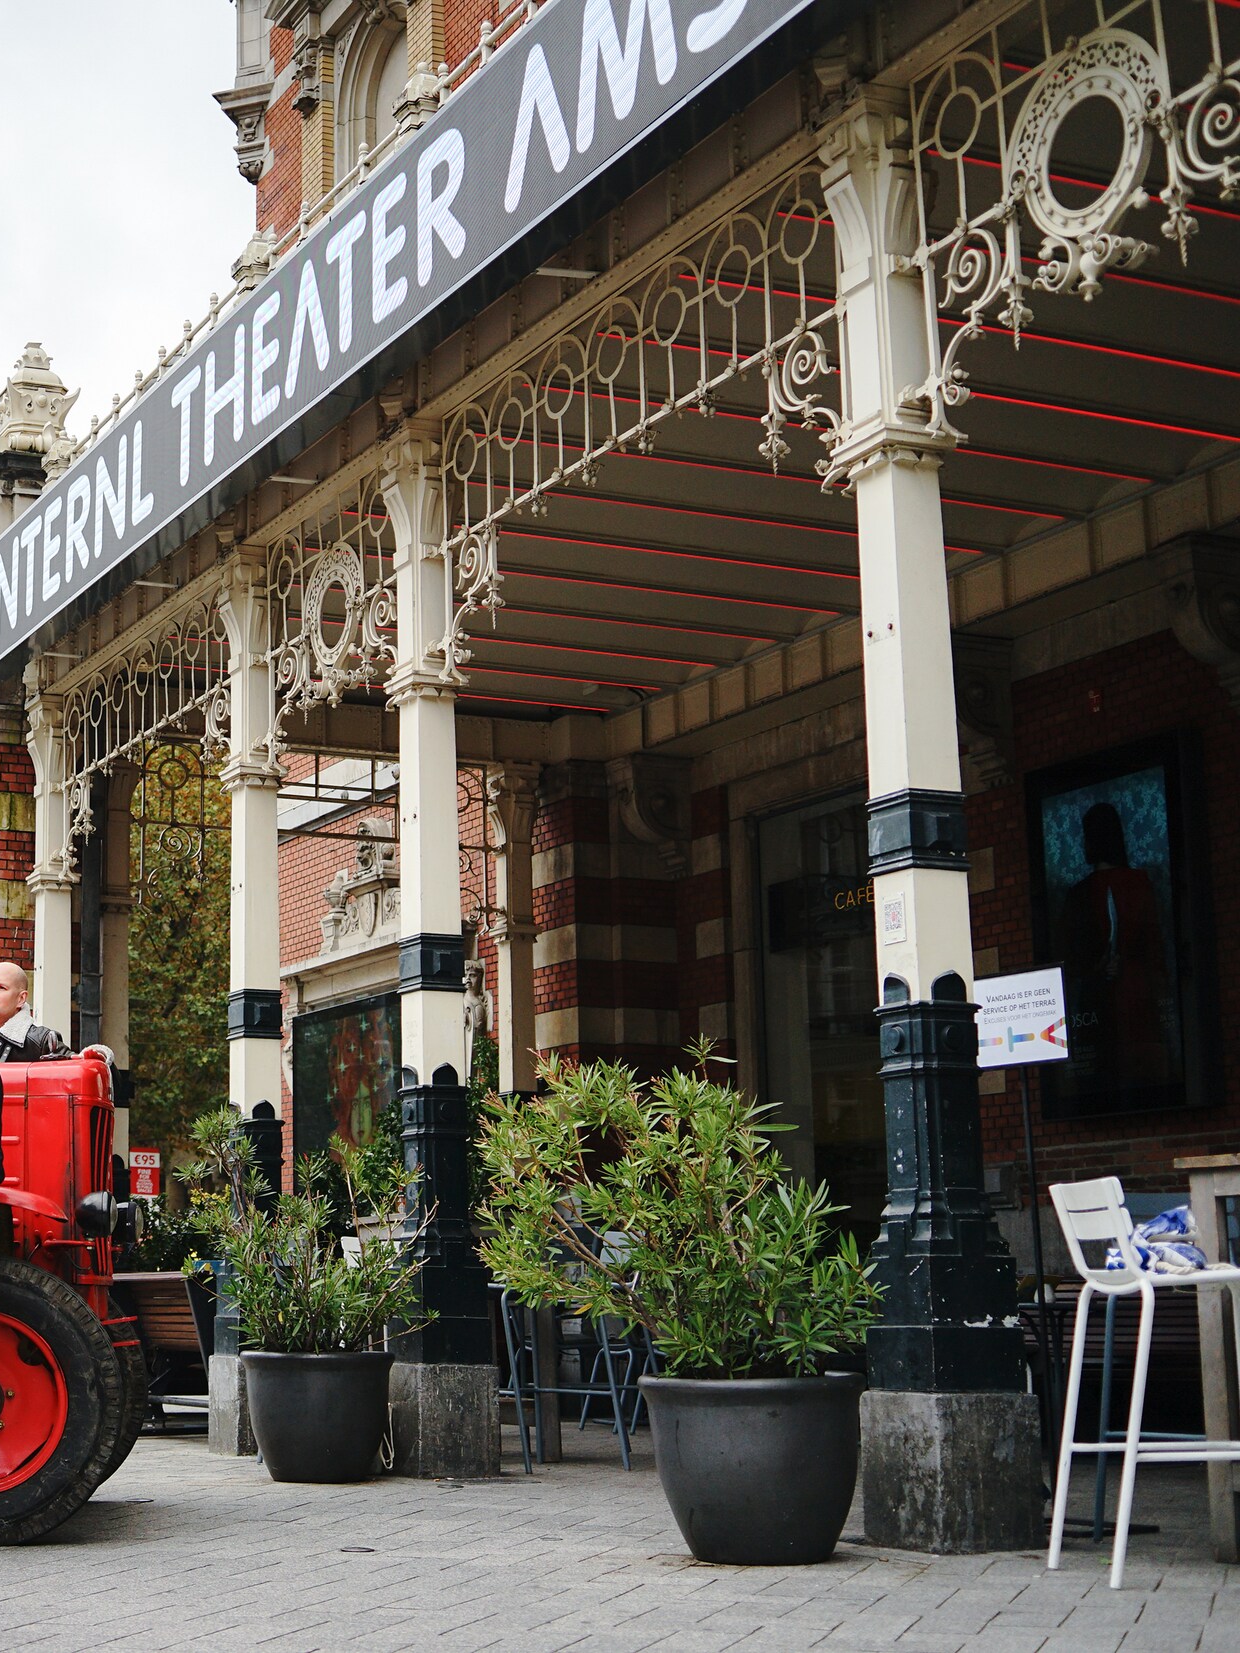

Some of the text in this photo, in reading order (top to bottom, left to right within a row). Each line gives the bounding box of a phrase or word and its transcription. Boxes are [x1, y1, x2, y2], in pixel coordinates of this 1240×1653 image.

[171, 128, 466, 487] THEATER
[835, 879, 875, 910] CAFÉ
[986, 993, 1016, 1003] VANDAAG
[1024, 990, 1033, 998] ER
[1033, 988, 1051, 997] GEEN
[983, 1005, 1008, 1015] SERVICE
[1009, 1004, 1017, 1012] OP
[1032, 999, 1057, 1008] TERRAS
[1008, 1014, 1021, 1022] VOOR
[135, 1155, 155, 1165] €95
